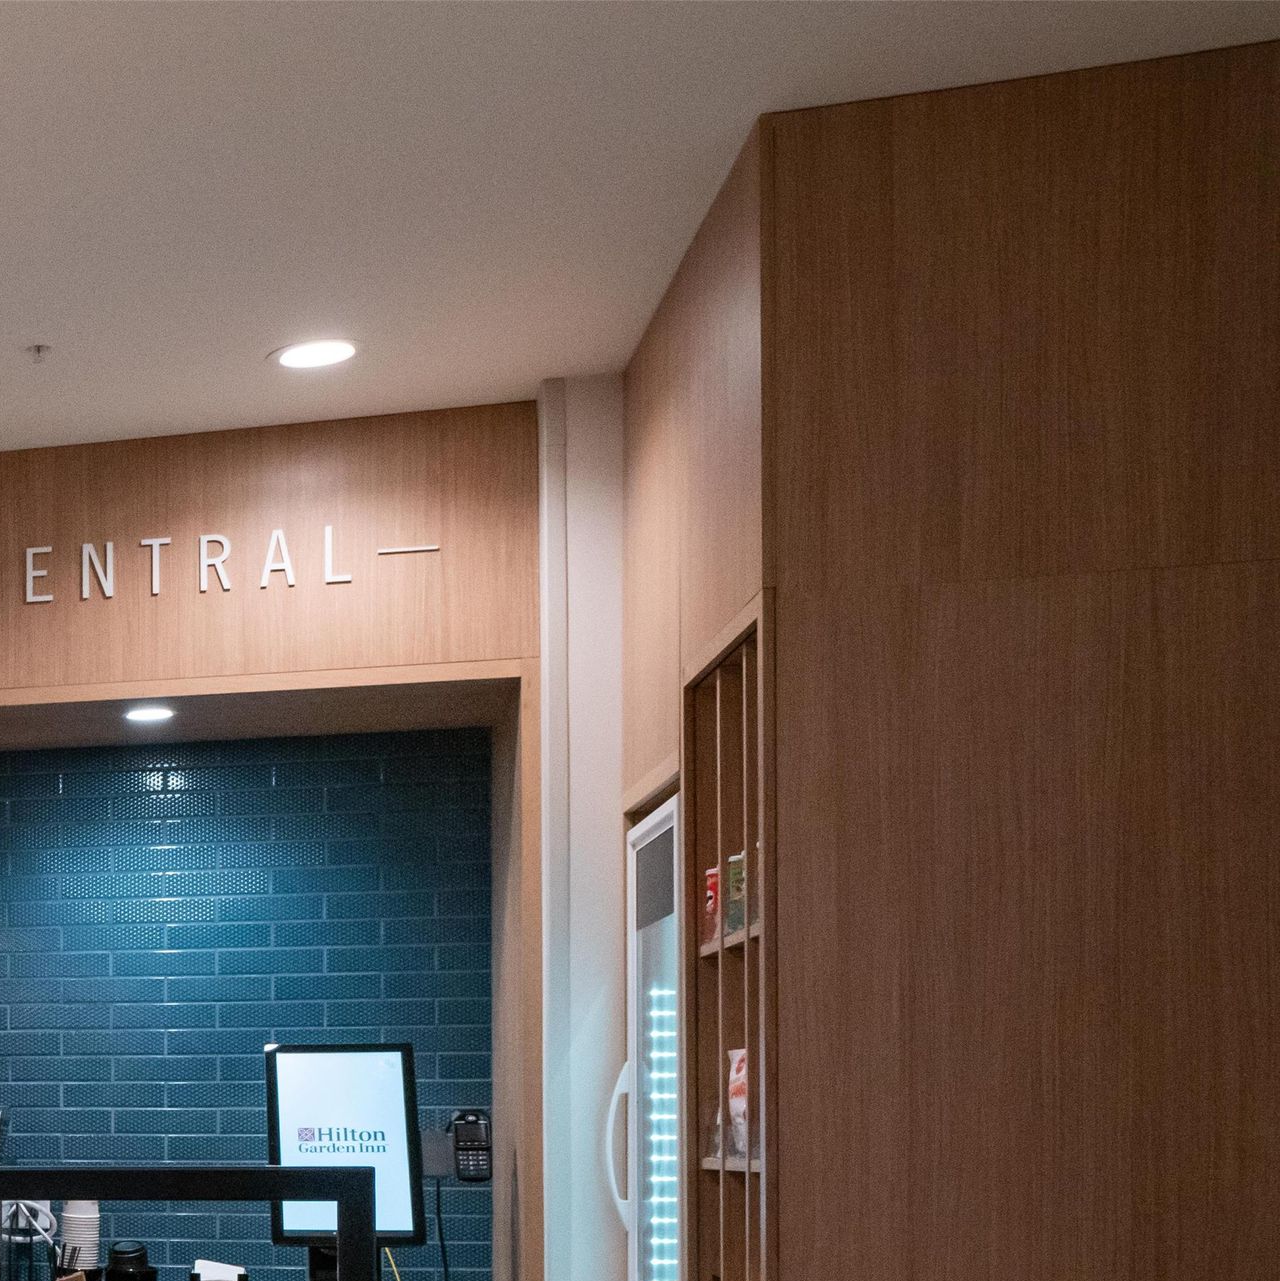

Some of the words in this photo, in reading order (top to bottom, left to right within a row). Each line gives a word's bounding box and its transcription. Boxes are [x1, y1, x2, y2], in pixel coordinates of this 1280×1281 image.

[318, 1127, 386, 1142] Hilton
[298, 1142, 358, 1153] Garden
[359, 1143, 387, 1153] Inn
